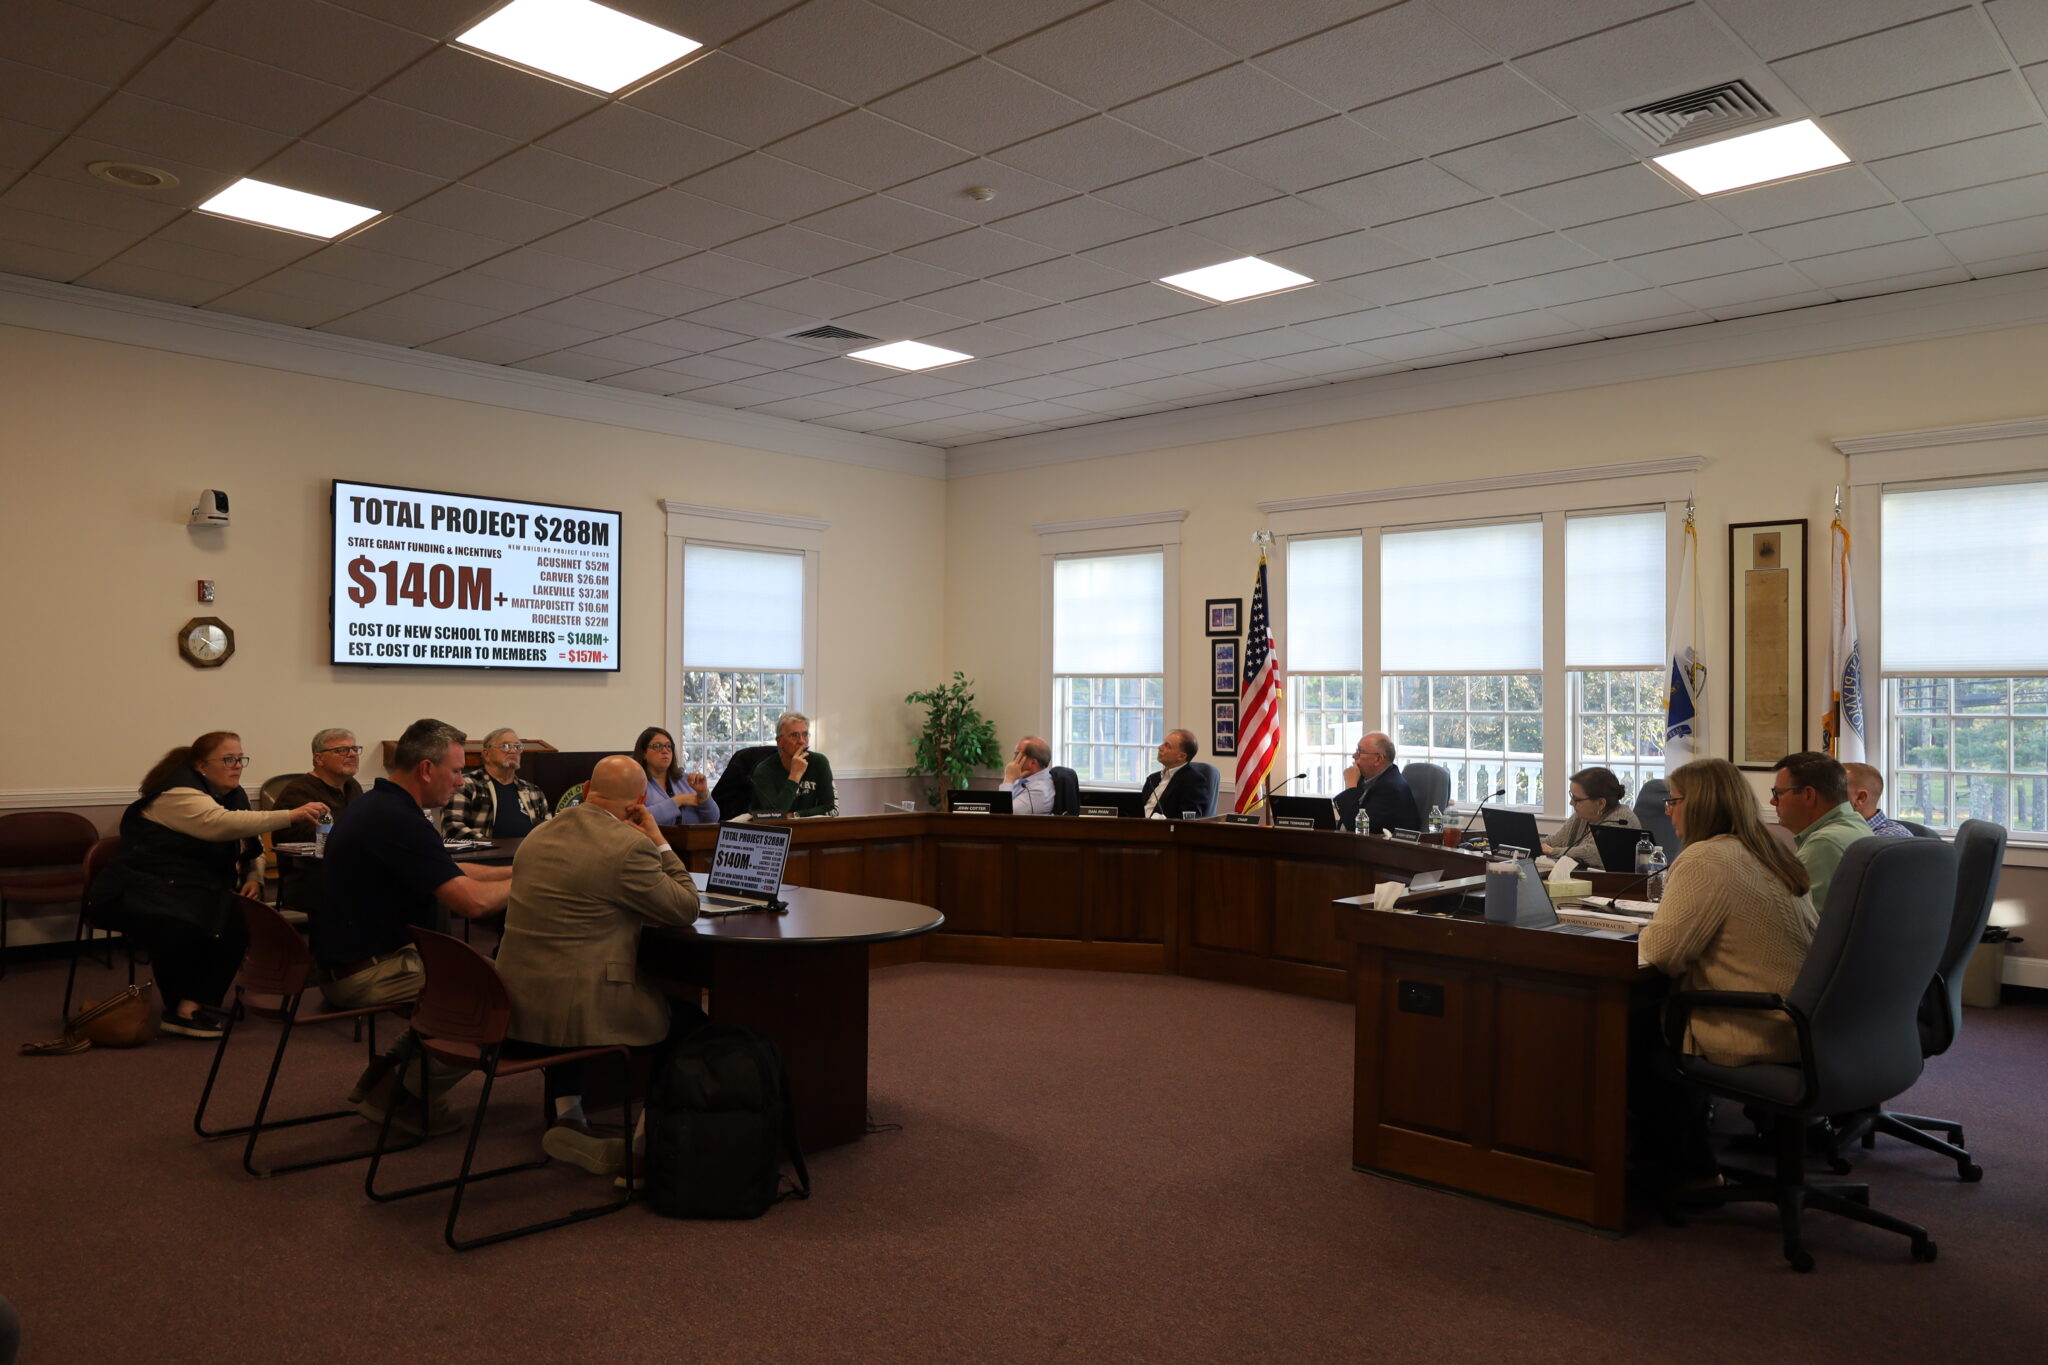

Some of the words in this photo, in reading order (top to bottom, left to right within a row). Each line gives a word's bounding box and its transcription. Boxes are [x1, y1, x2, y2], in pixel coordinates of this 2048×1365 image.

[350, 496, 425, 529] TOTAL
[431, 505, 529, 538] PROJECT
[535, 515, 609, 546] $288M
[348, 537, 375, 549] STATE
[376, 539, 406, 551] GRANT
[407, 542, 445, 554] FUNDING
[447, 546, 453, 555] &
[454, 546, 502, 558] INCENTIVES
[537, 557, 582, 570] ACUSHNET
[585, 560, 609, 572] $52M
[348, 555, 508, 611] $140M+
[540, 572, 573, 583] CARVER
[577, 573, 609, 586] $26.6M
[533, 585, 575, 597] LAKEVILLE
[579, 587, 609, 599] $37.3M
[511, 598, 574, 611] MATTAPOISETT
[578, 601, 609, 613] $10.6M
[532, 614, 582, 626] ROCHESTER
[585, 616, 609, 627] $22M
[349, 622, 383, 637] COST
[386, 624, 401, 638] OF
[404, 626, 432, 639] NEW
[435, 627, 481, 641] SCHOOL
[484, 629, 498, 642] TO
[501, 630, 555, 644] MEMBERS
[567, 633, 609, 646] $148M+
[349, 643, 374, 656] EST.
[376, 645, 410, 658] COST
[413, 646, 428, 658] OF
[430, 647, 472, 659] REPAIR
[475, 648, 489, 660] TO
[492, 648, 546, 662] MEMBERS
[569, 651, 608, 663] $157M+
[722, 831, 737, 841] TOTAL
[739, 833, 763, 844] PROJECT
